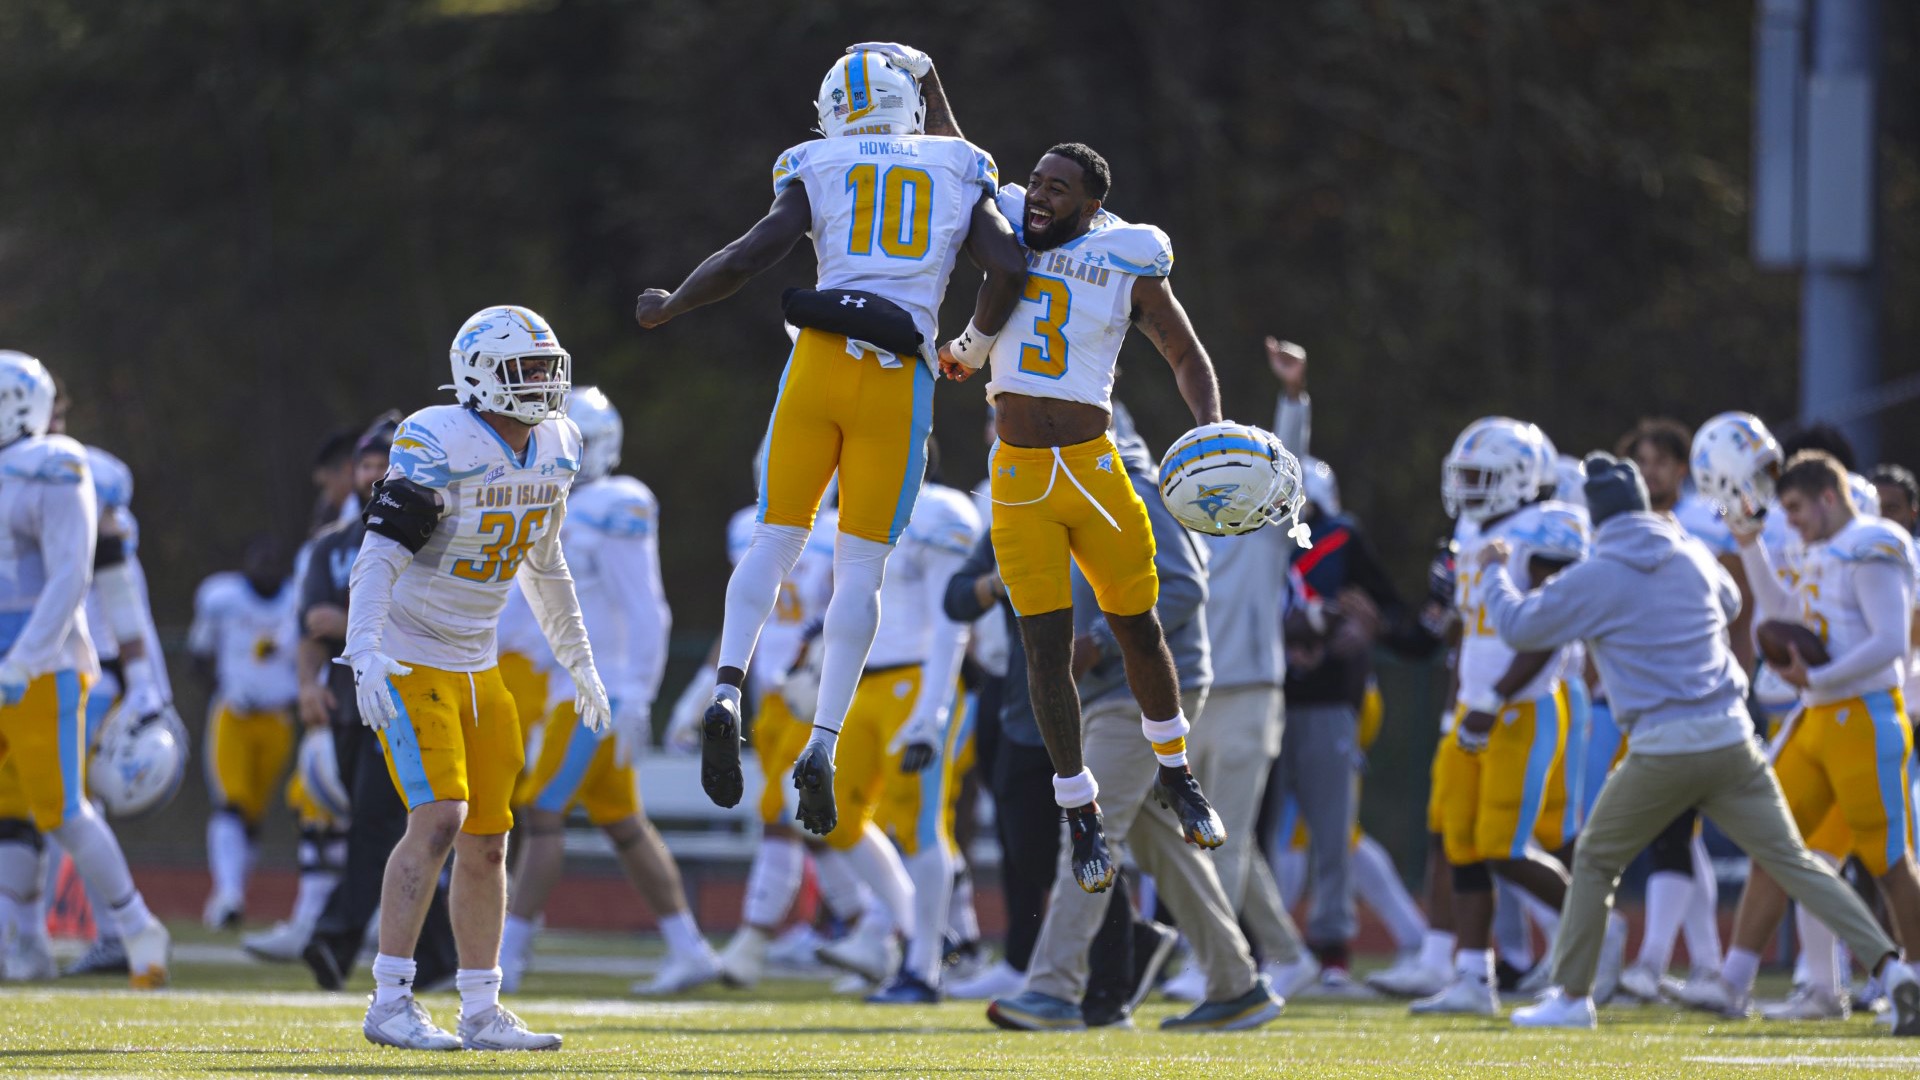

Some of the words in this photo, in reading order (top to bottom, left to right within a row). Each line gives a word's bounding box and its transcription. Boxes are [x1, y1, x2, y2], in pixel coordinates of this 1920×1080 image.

[859, 141, 918, 157] HOWELL
[845, 163, 934, 261] 10
[1046, 252, 1110, 287] ISLAND
[1018, 271, 1072, 380] 3
[476, 485, 512, 507] LONG
[517, 484, 559, 506] ISLAND
[450, 507, 550, 583] 36
